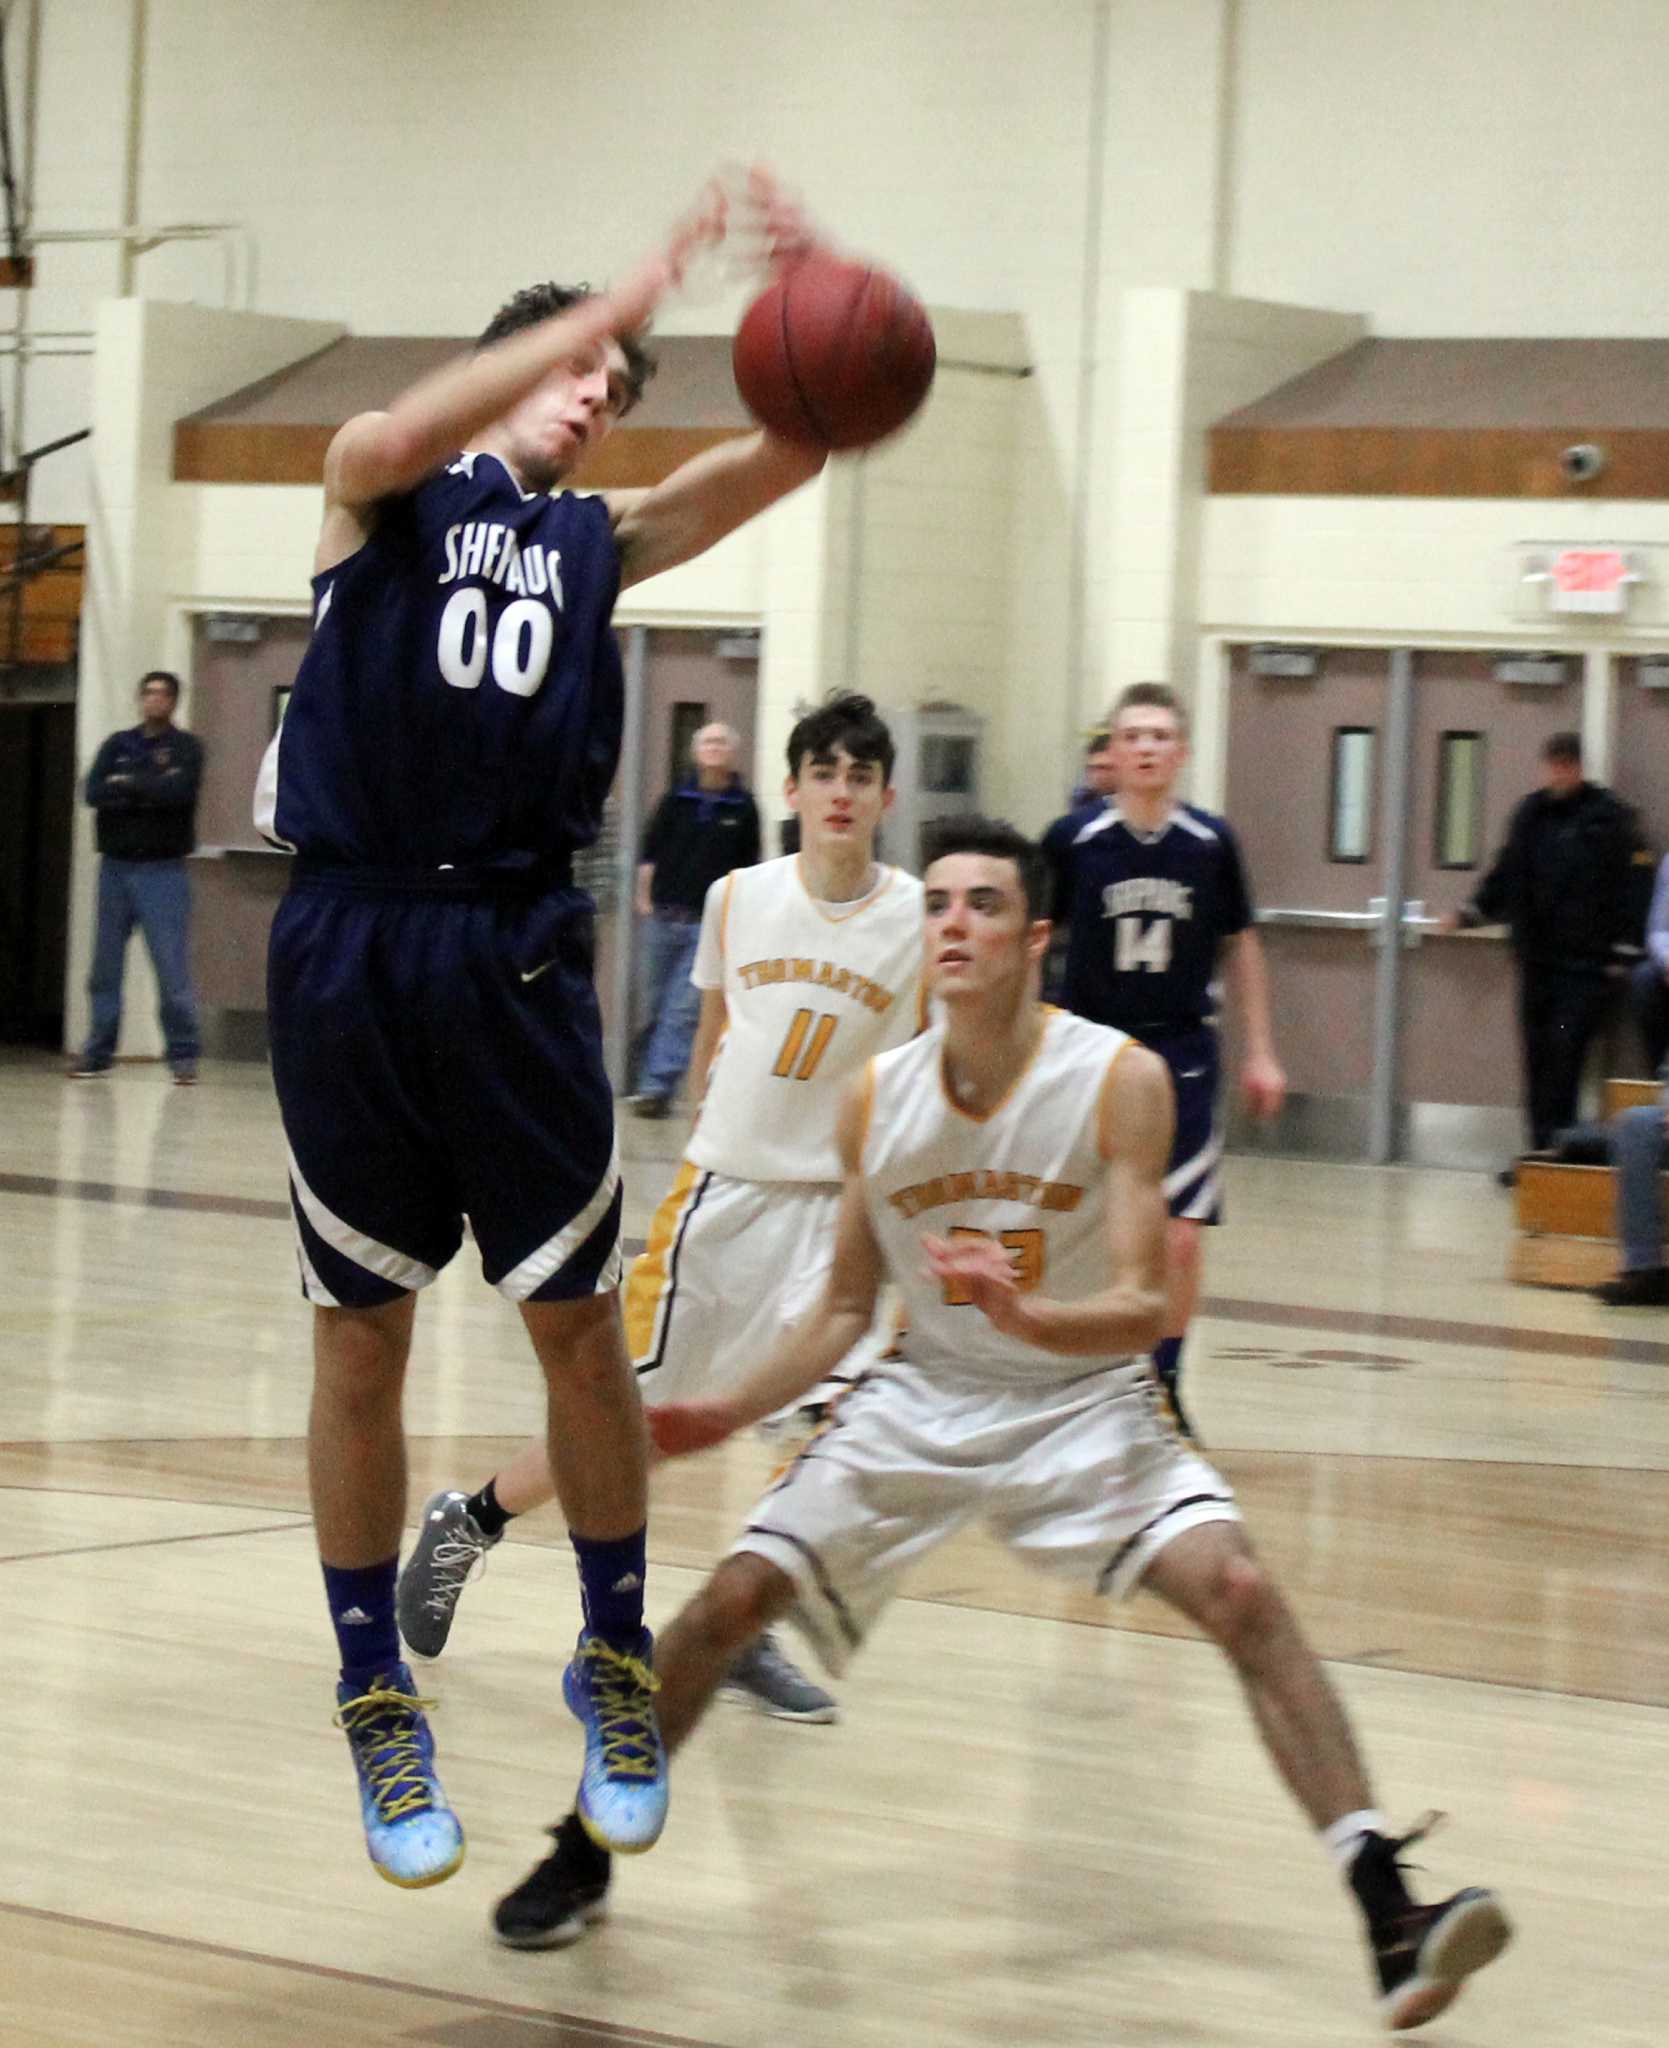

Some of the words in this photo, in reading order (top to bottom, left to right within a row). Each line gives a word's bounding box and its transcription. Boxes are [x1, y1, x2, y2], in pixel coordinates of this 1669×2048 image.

[436, 586, 554, 697] 00
[1114, 917, 1172, 974] 14
[770, 1007, 840, 1081] 11
